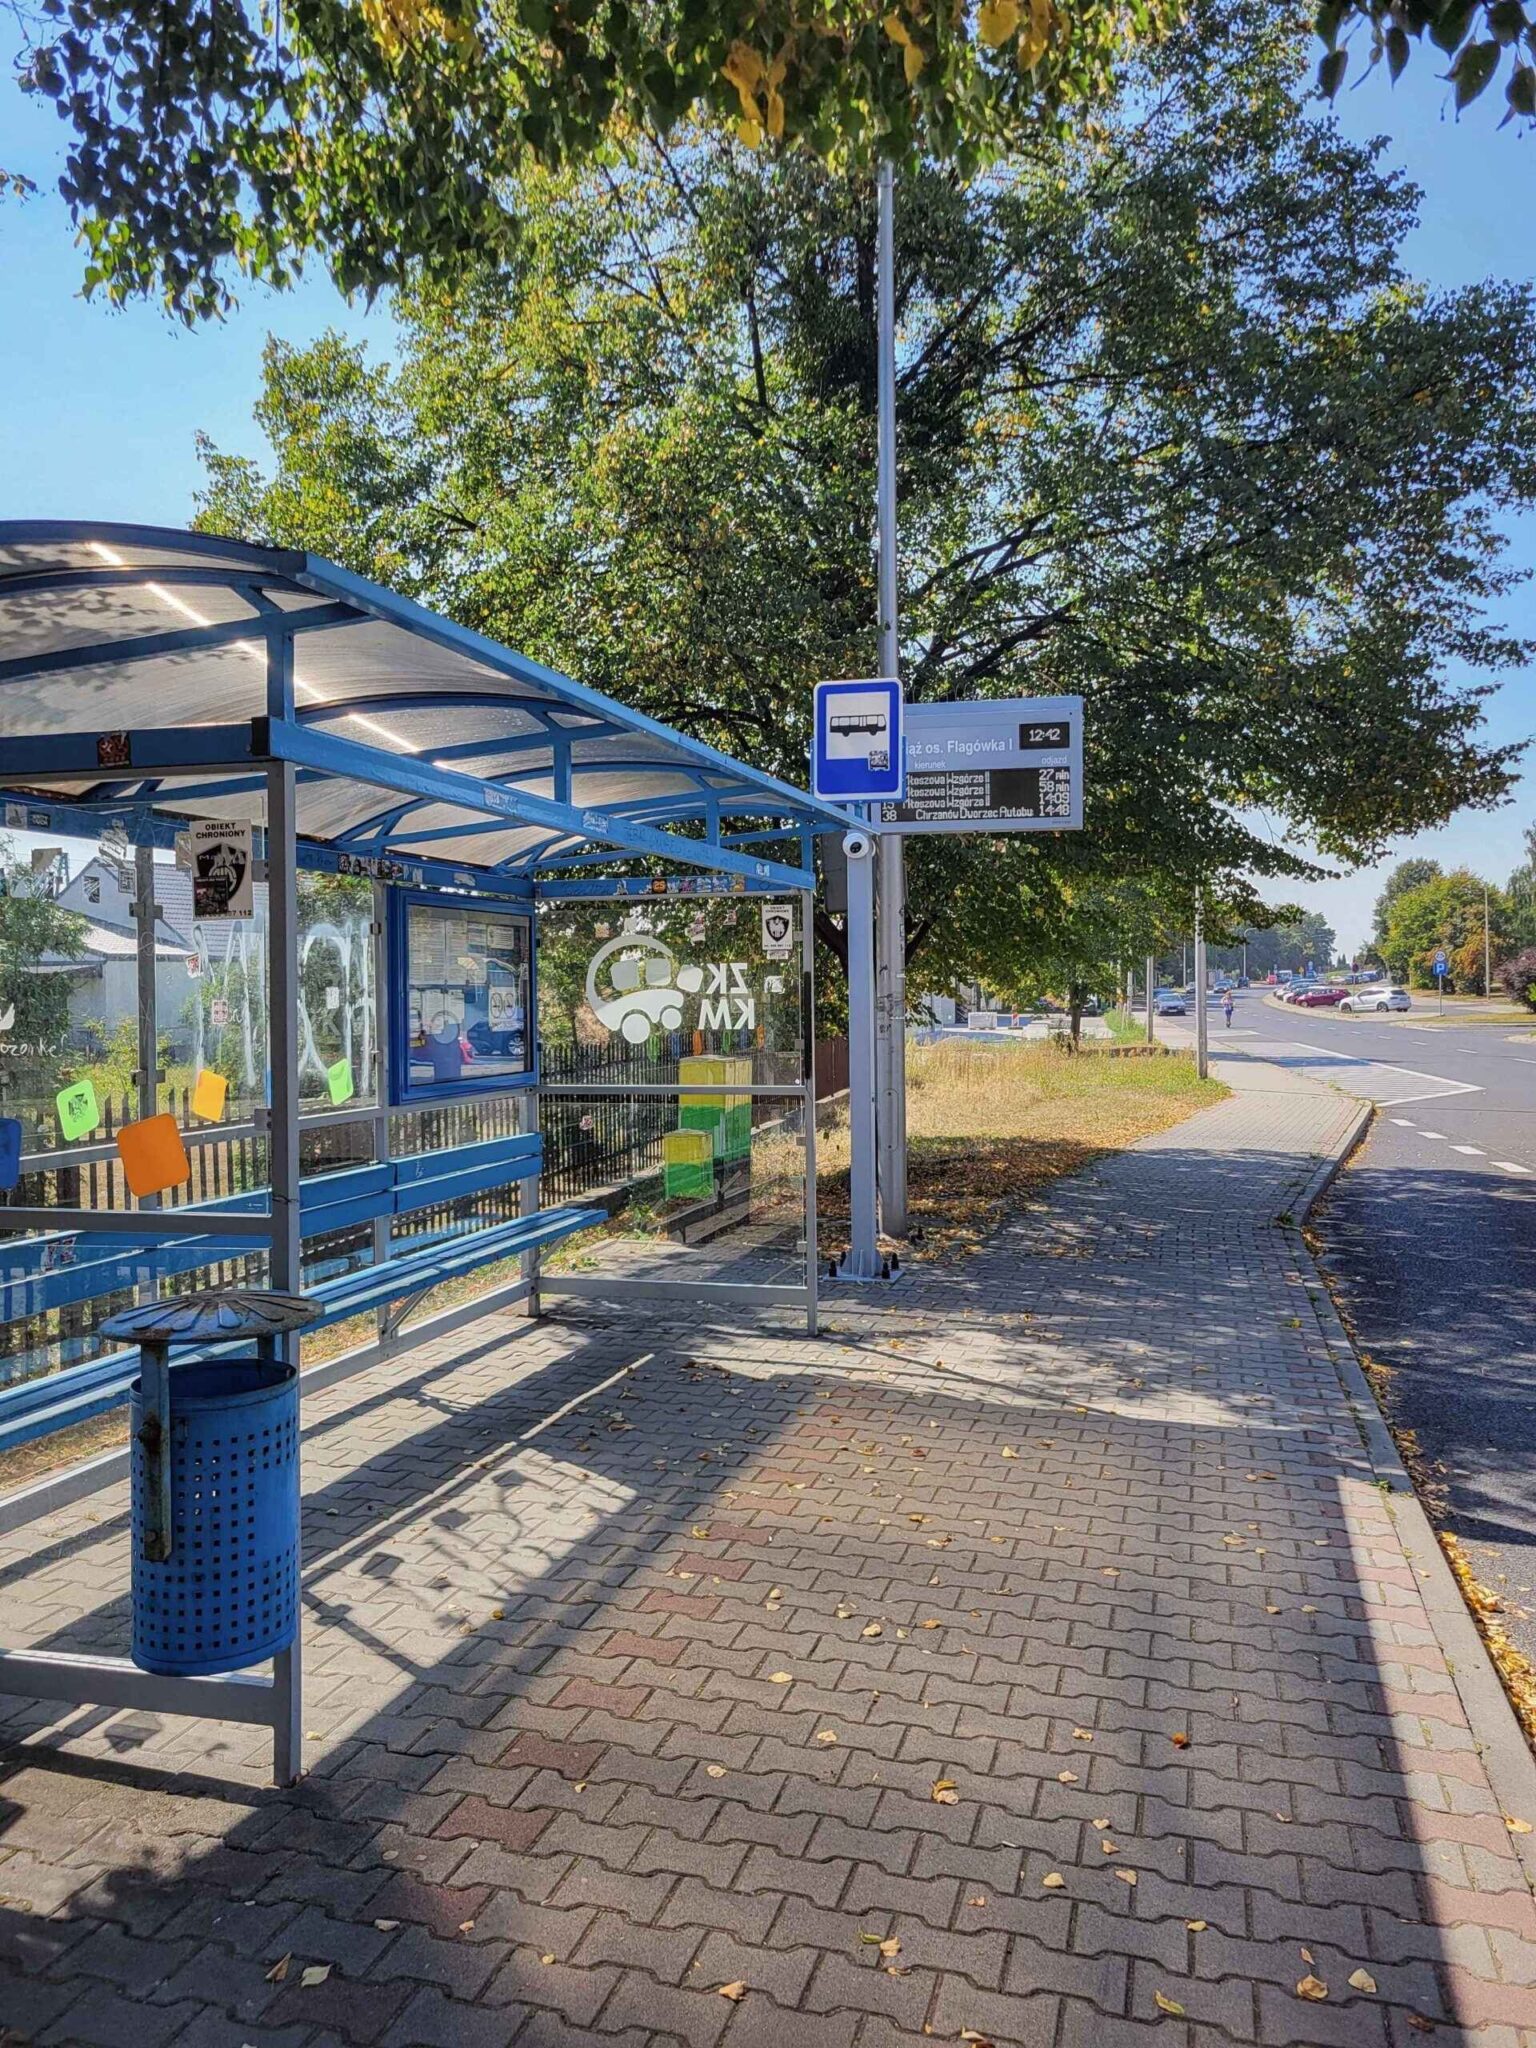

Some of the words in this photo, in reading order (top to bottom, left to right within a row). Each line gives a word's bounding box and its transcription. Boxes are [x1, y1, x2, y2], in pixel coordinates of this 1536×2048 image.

[1029, 729, 1060, 741] 12:42
[925, 743, 943, 753] os.
[947, 739, 1005, 755] Flagówka
[914, 760, 946, 769] kierunek
[1041, 756, 1067, 767] odjazd
[946, 772, 984, 784] Wzgórze
[1038, 769, 1053, 780] 27
[1055, 770, 1070, 779] min
[946, 784, 984, 796] Wzgórze
[1038, 781, 1053, 792] 58
[1055, 782, 1070, 791] min
[946, 796, 984, 808] Wzgórze
[1038, 792, 1070, 804] 14:09
[882, 810, 897, 821] 38
[915, 808, 959, 820] Chrzanów
[959, 804, 998, 818] Dworzec
[1038, 804, 1070, 816] 14:48
[204, 822, 237, 831] OBIEKT
[195, 830, 246, 839] CHRONIONY
[1436, 963, 1445, 973] P
